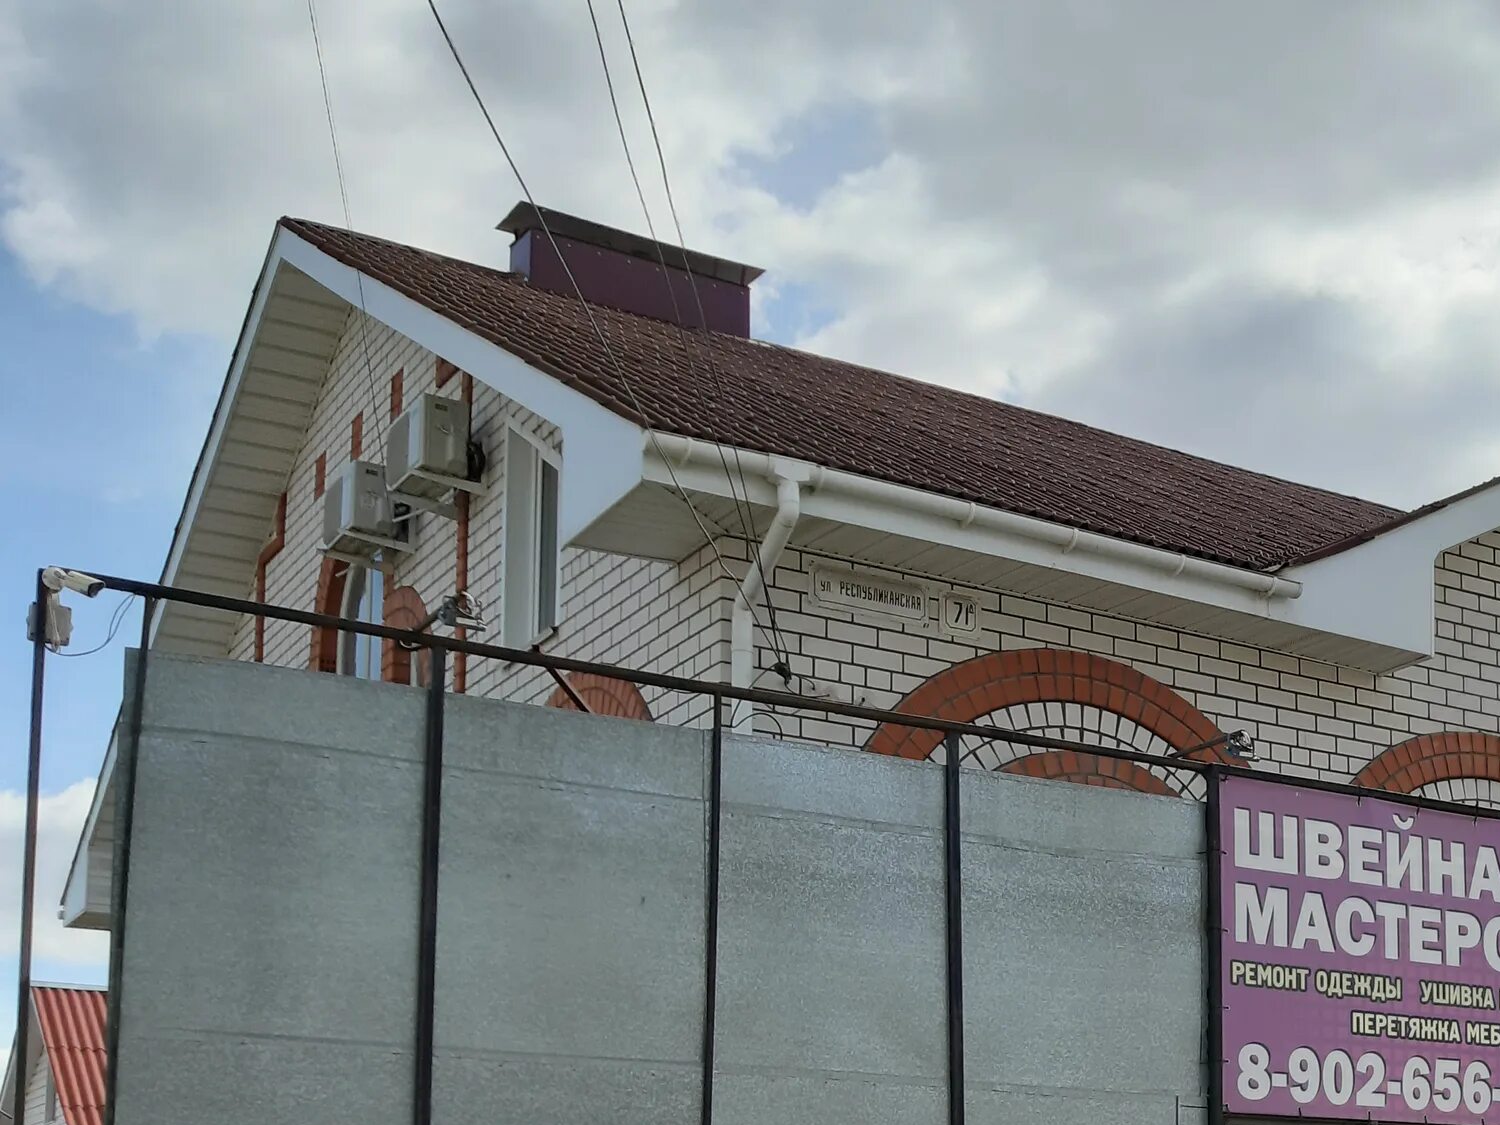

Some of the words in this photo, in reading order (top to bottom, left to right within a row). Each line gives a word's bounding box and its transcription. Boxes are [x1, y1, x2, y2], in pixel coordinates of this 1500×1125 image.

[840, 580, 922, 611] РЕСПУБЛИКАНСКАЯ
[1231, 960, 1309, 992] РЕМОНТ
[1315, 968, 1403, 1002] ОДЕЖДЫ
[1419, 980, 1495, 1011] УШИВКА
[1351, 1010, 1461, 1043] ПЕРЕТЯЖКА
